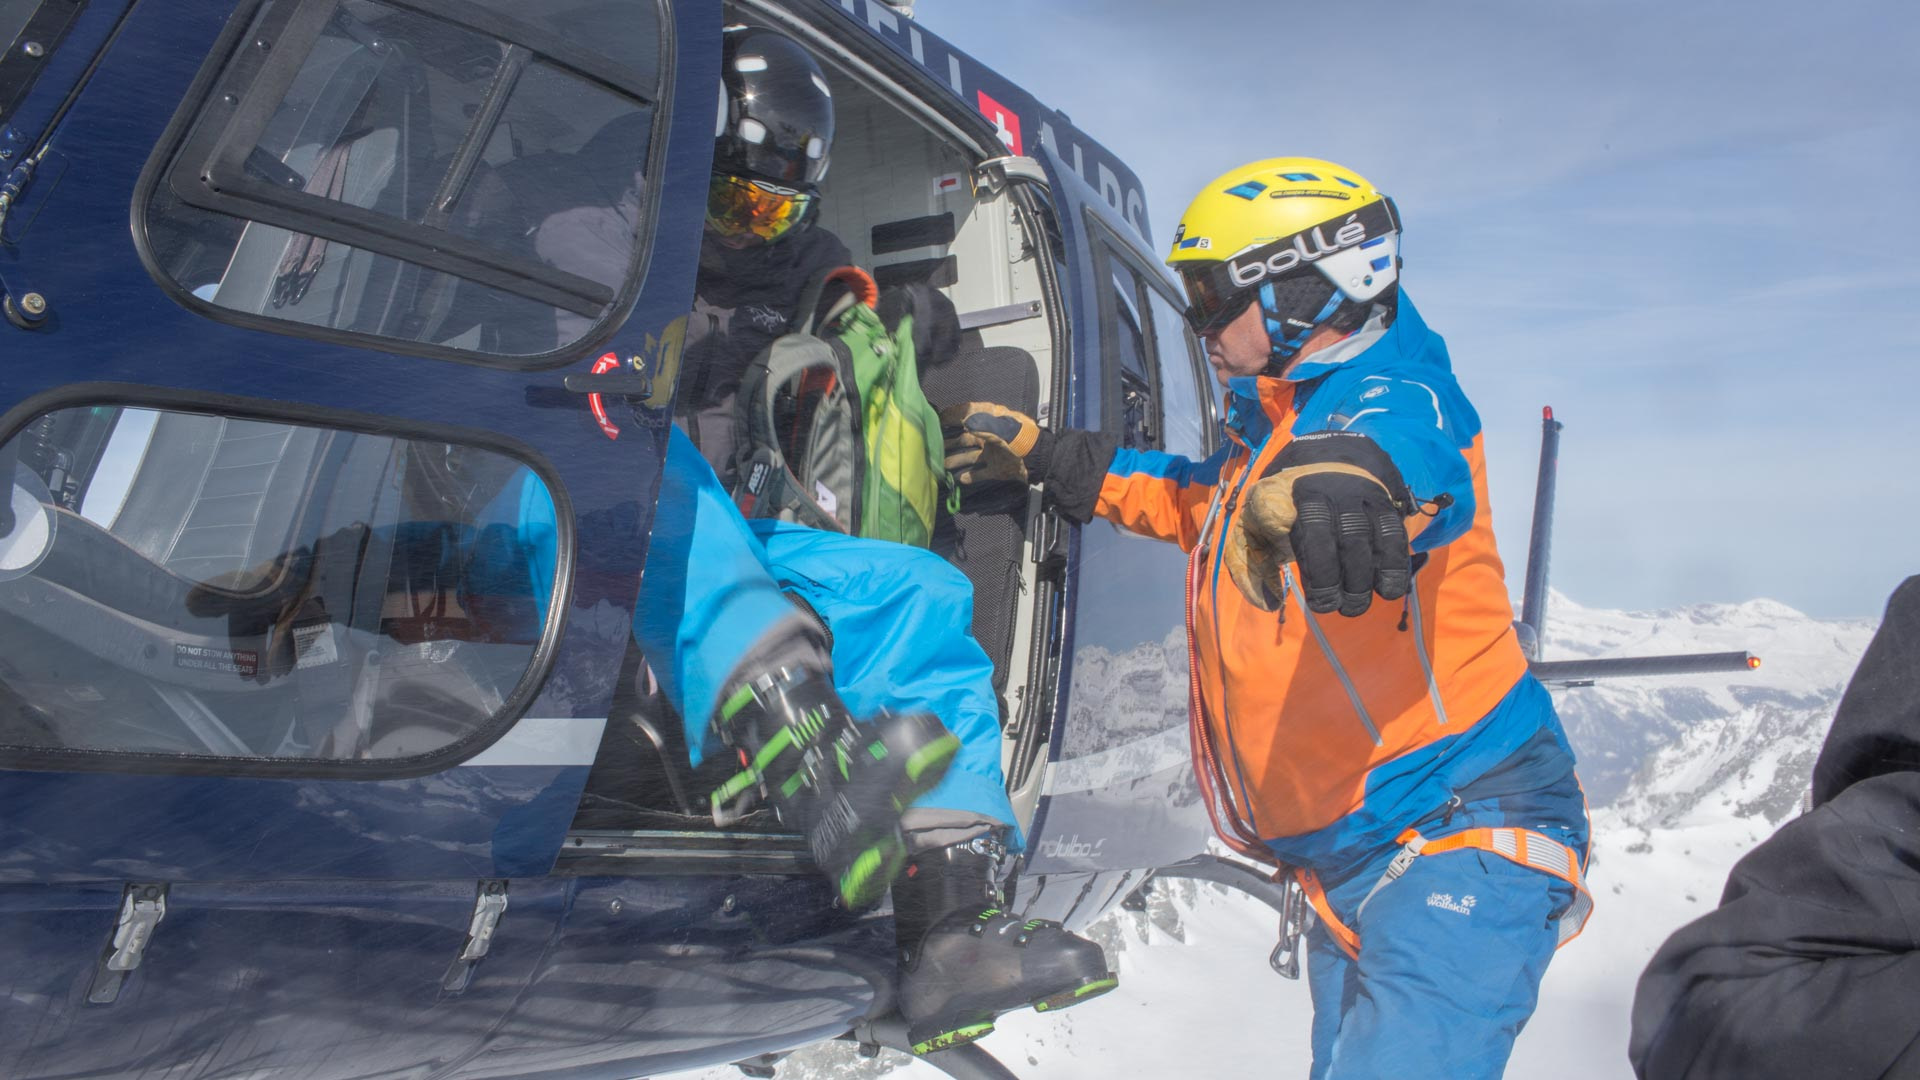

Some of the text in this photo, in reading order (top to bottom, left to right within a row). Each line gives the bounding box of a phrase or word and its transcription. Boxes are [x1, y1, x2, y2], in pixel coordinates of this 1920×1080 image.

[1227, 213, 1366, 288] bollé
[748, 463, 764, 494] ABS
[176, 645, 257, 662] DO NOT STOW ANYTHING
[178, 658, 254, 674] UNDER ALL THE SEATS
